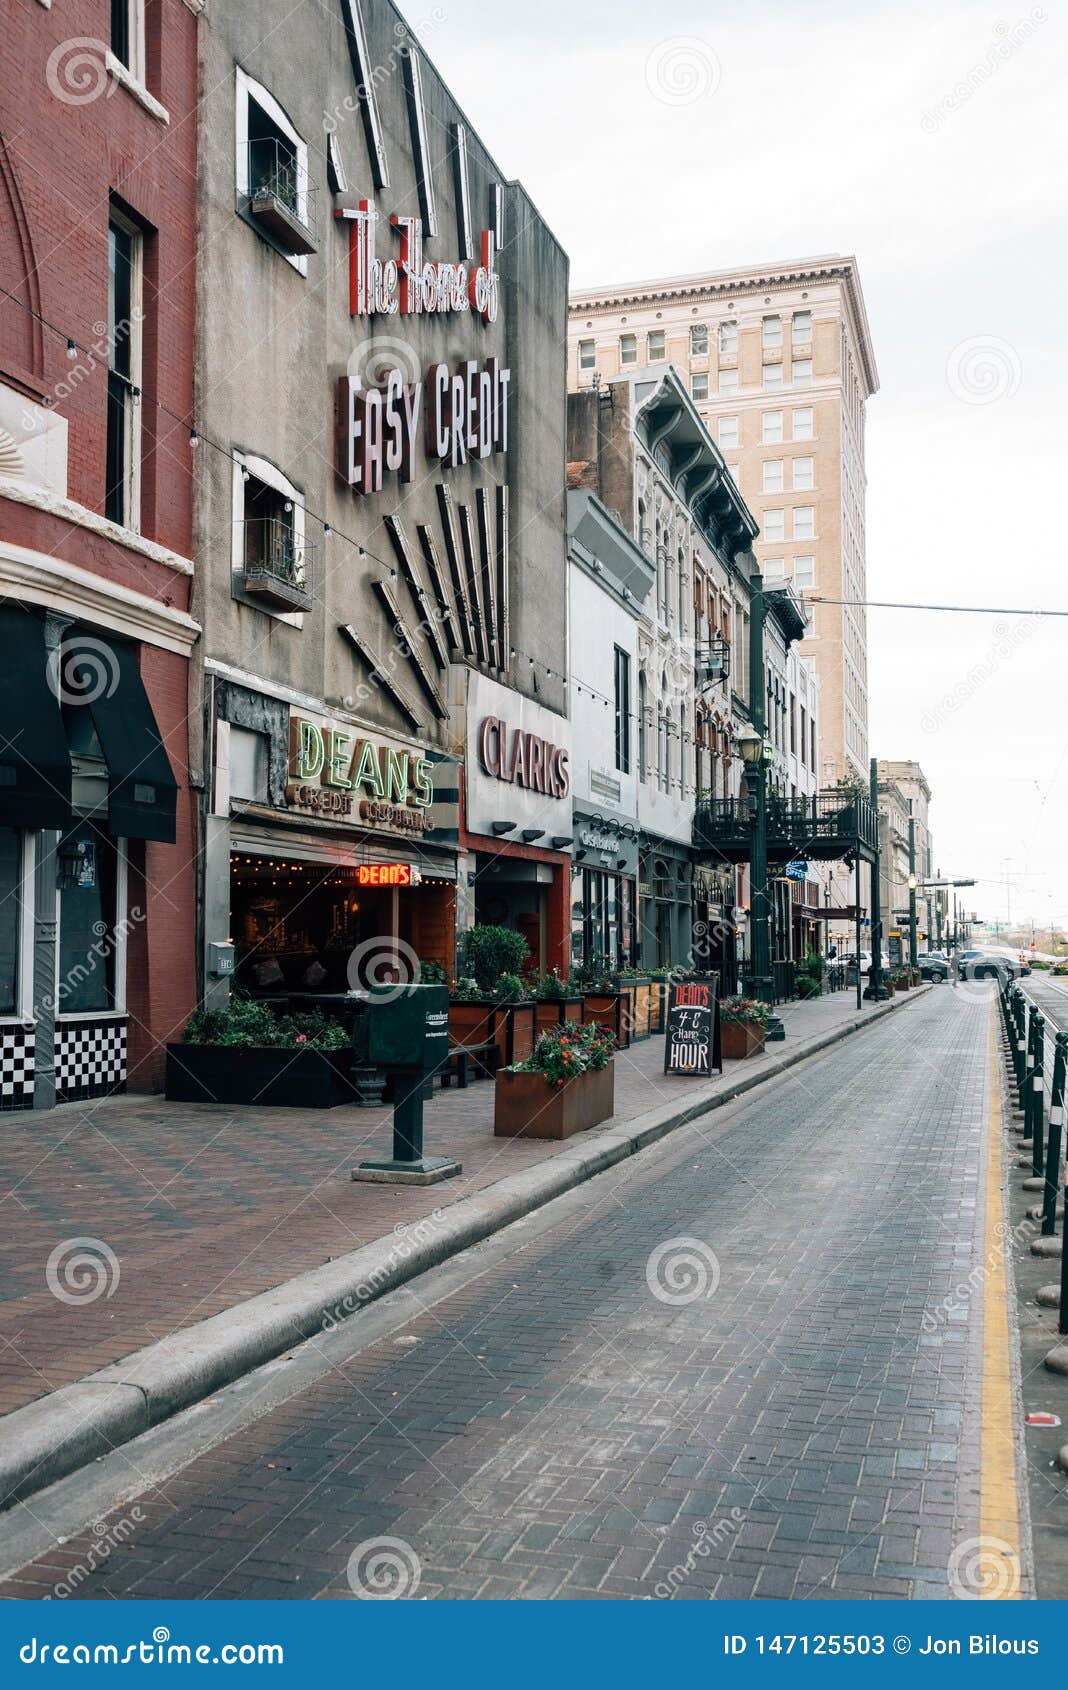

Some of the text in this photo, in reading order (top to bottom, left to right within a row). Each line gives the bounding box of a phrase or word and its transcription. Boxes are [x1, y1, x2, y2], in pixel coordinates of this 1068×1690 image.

[335, 199, 499, 323] The Home of
[341, 366, 422, 493] EASY
[430, 357, 511, 468] CREDIT
[480, 716, 570, 799] CLARKS
[286, 784, 353, 815] CREDIT
[359, 864, 409, 884] DEAN'S
[675, 985, 709, 1006] DEAN'S
[670, 1043, 709, 1068] HOUR
